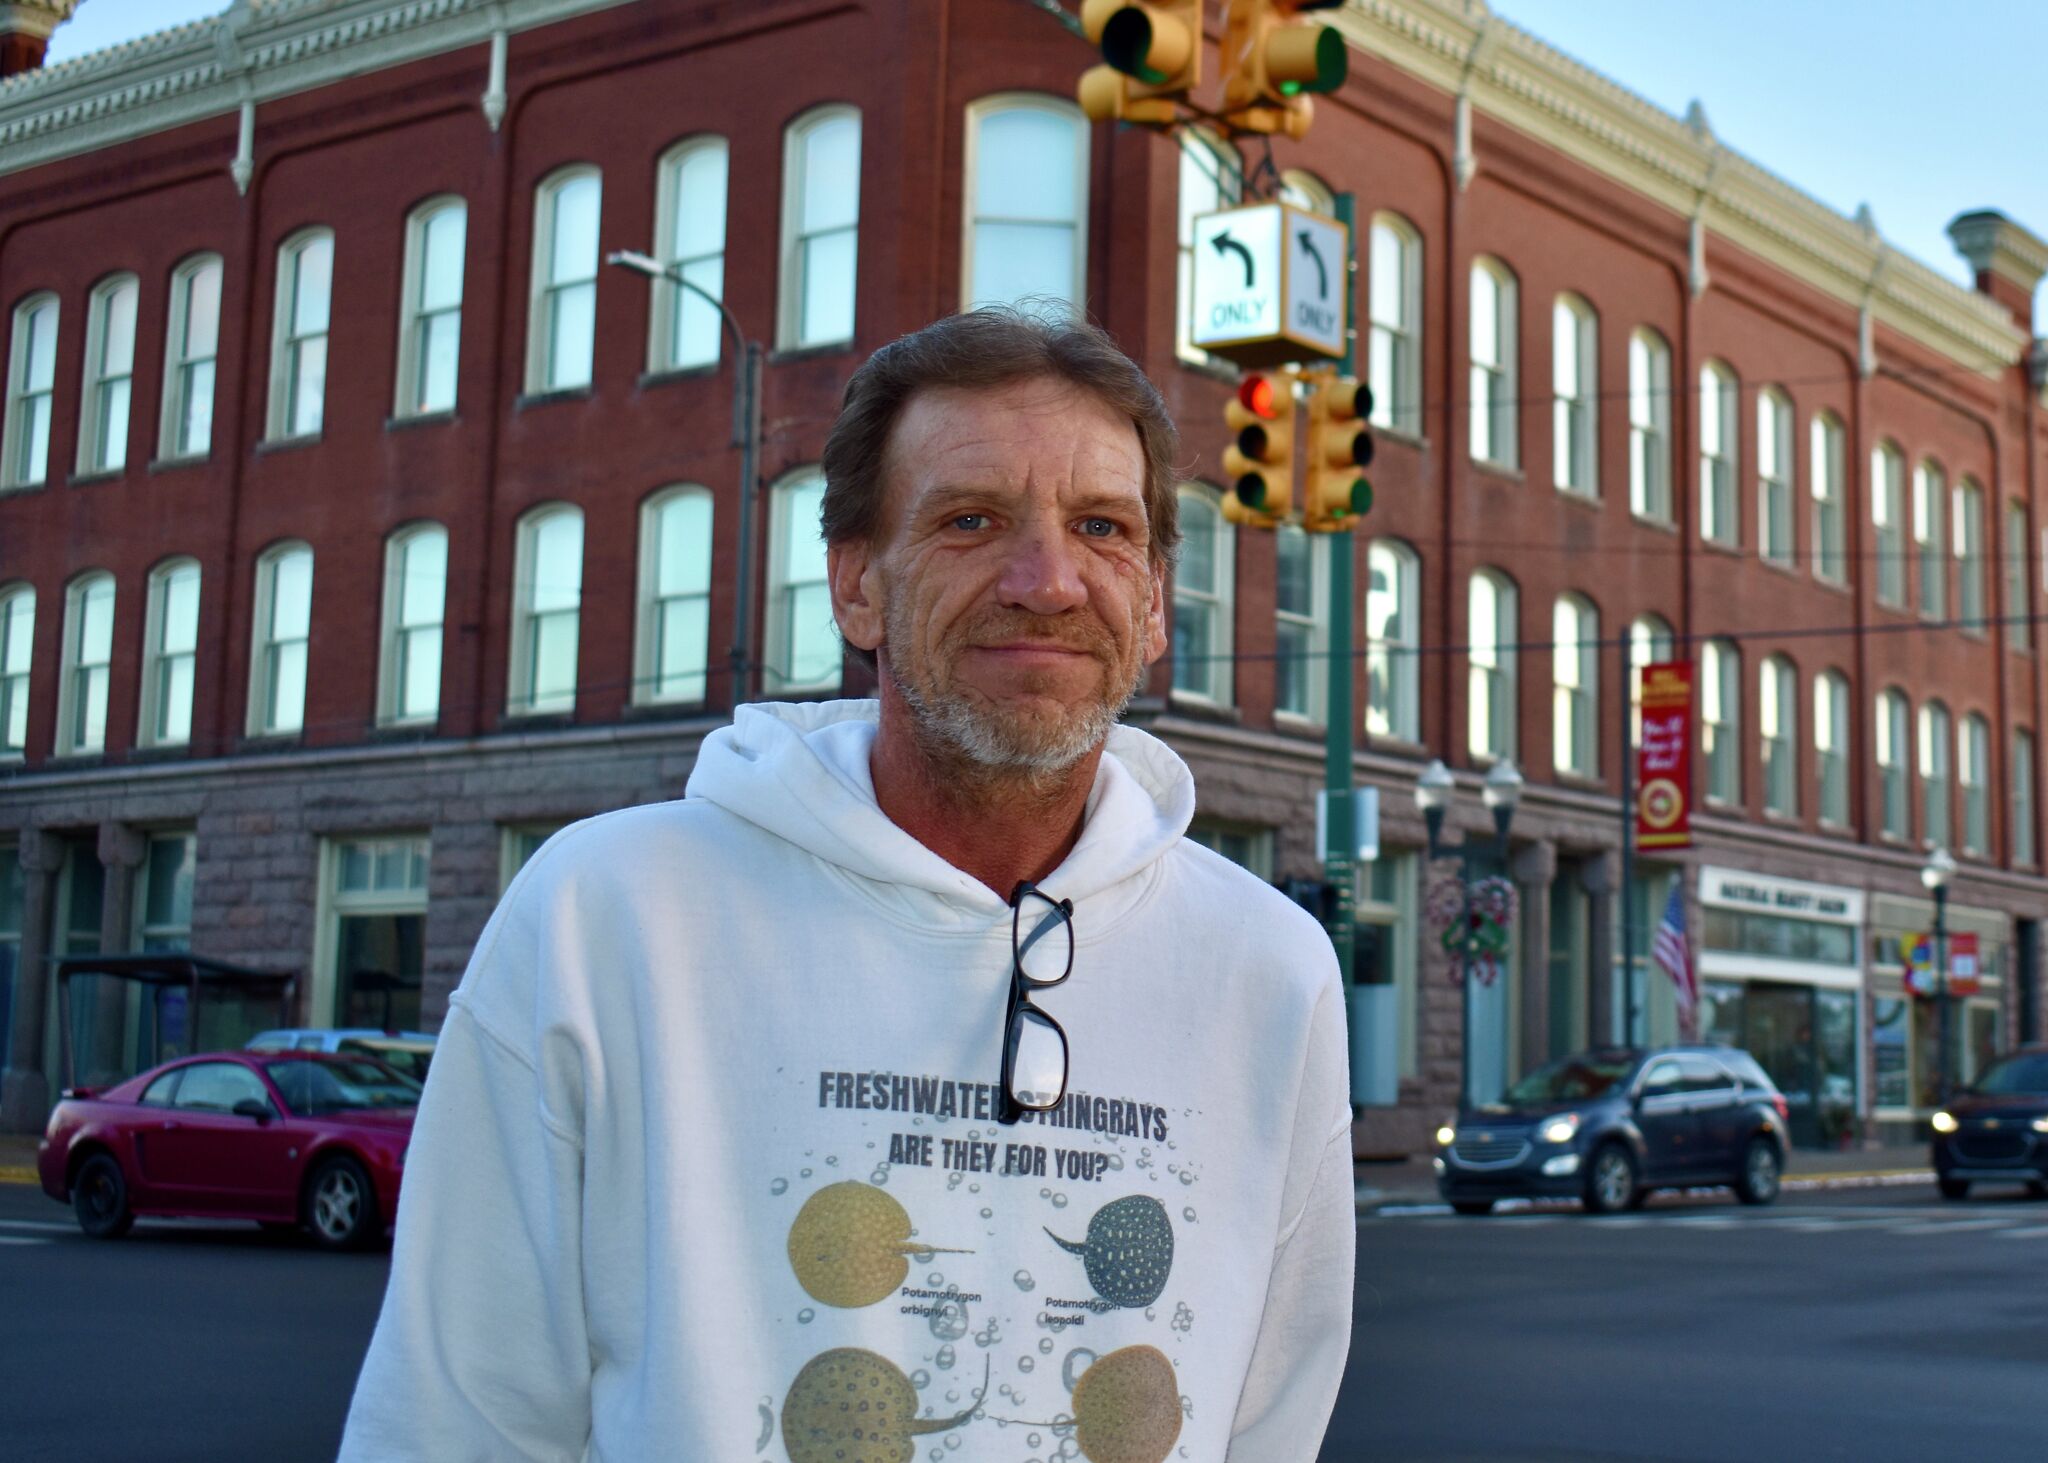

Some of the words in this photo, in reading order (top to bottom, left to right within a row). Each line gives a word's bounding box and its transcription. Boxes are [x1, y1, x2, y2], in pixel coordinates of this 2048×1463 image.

[1211, 298, 1267, 328] ONLY
[1297, 302, 1337, 334] ONLY
[889, 1133, 933, 1167] ARE
[941, 1138, 997, 1173] THEY
[1005, 1143, 1047, 1177] FOR
[1055, 1148, 1109, 1182] YOU?
[902, 1287, 982, 1303] Potamotrygon
[1045, 1297, 1121, 1312] Potamotrygon
[1045, 1313, 1085, 1326] leopoldi
